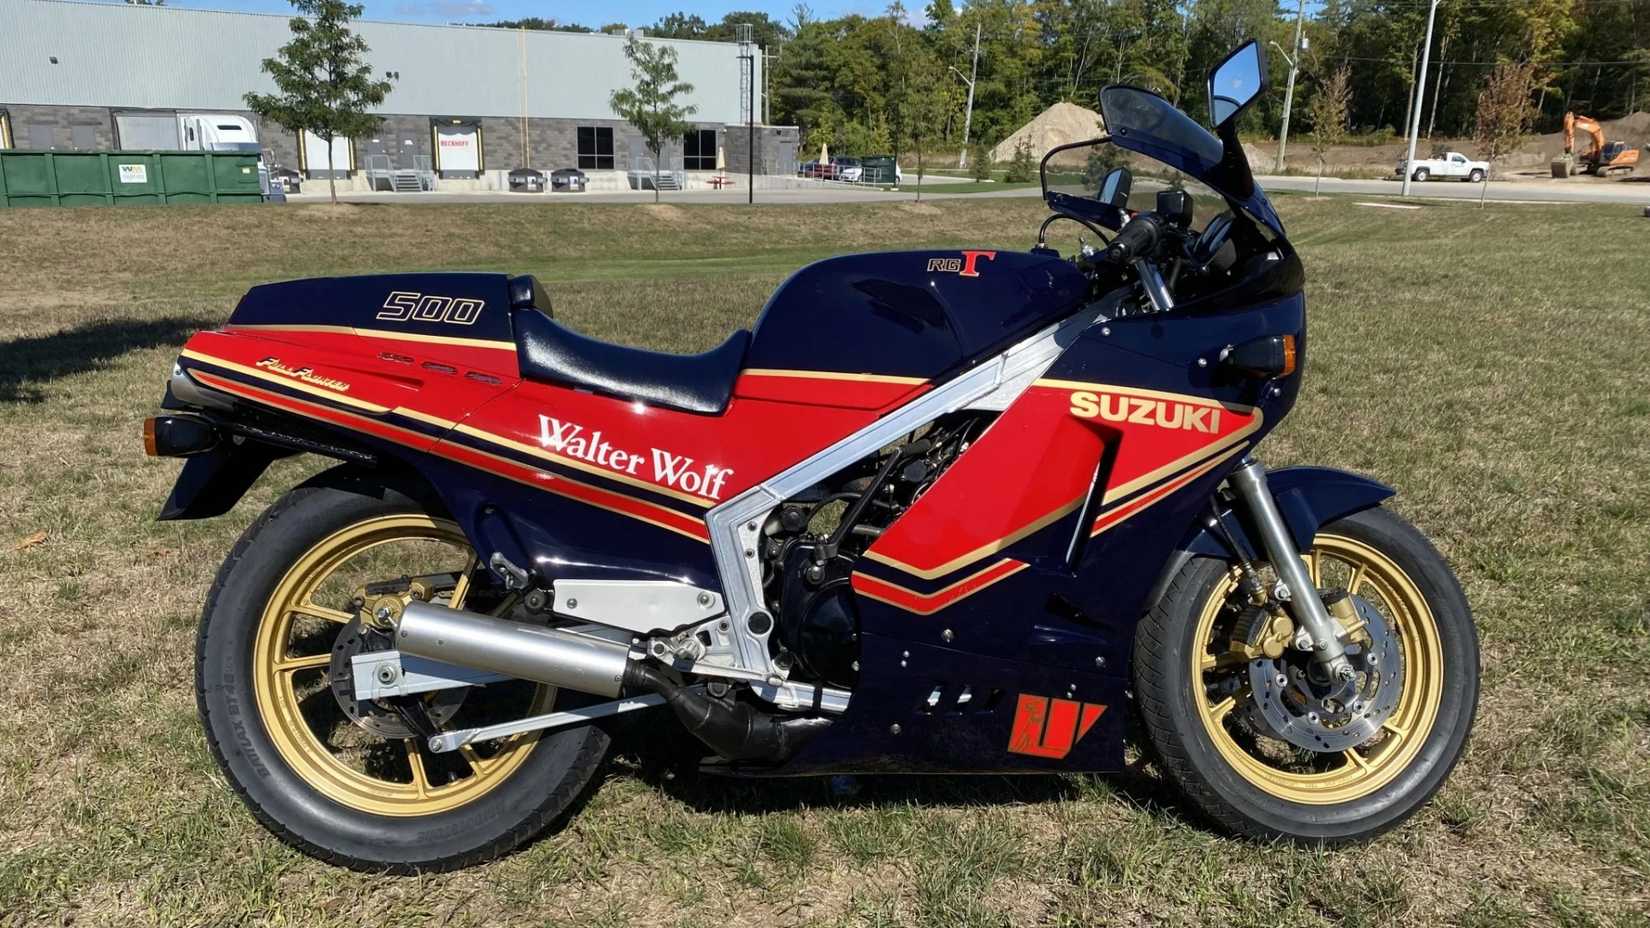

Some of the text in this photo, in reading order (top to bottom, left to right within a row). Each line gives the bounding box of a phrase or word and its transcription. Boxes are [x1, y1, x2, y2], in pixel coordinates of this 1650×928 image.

[376, 291, 485, 325] 500
[1070, 391, 1221, 434] SUZUKI
[538, 414, 735, 500] Walter Wolf
